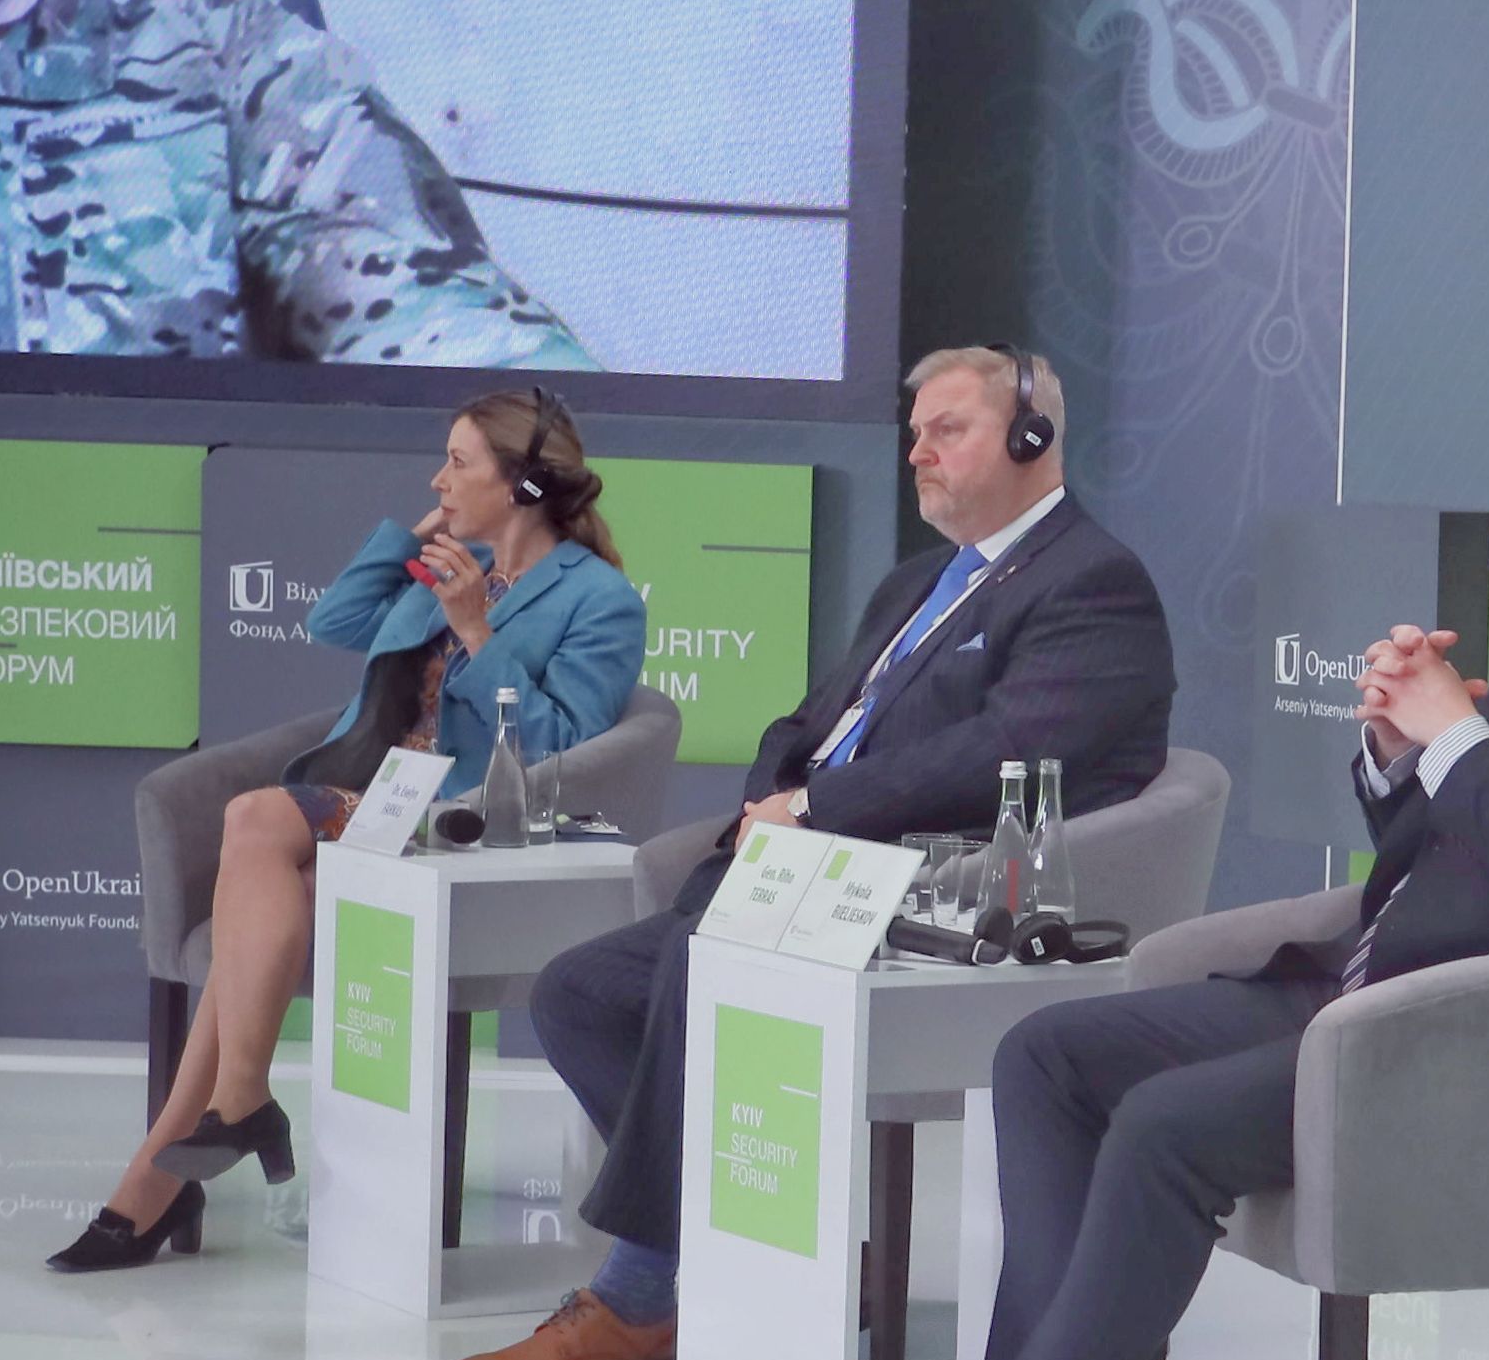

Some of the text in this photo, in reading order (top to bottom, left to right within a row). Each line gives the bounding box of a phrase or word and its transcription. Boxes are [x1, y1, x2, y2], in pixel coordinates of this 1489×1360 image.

[230, 620, 286, 642] Фонд
[645, 627, 755, 659] URITY
[1275, 695, 1354, 722] Arseniy Yatsenyuk
[3, 869, 141, 900] OpenUkrai
[11, 912, 85, 930] Yatsenyuk
[348, 982, 371, 1003] KYIV
[347, 1007, 396, 1038] SECURITY
[732, 1103, 763, 1128] KYIV
[732, 1133, 797, 1168] SECURITY
[731, 1162, 777, 1195] FORUM
